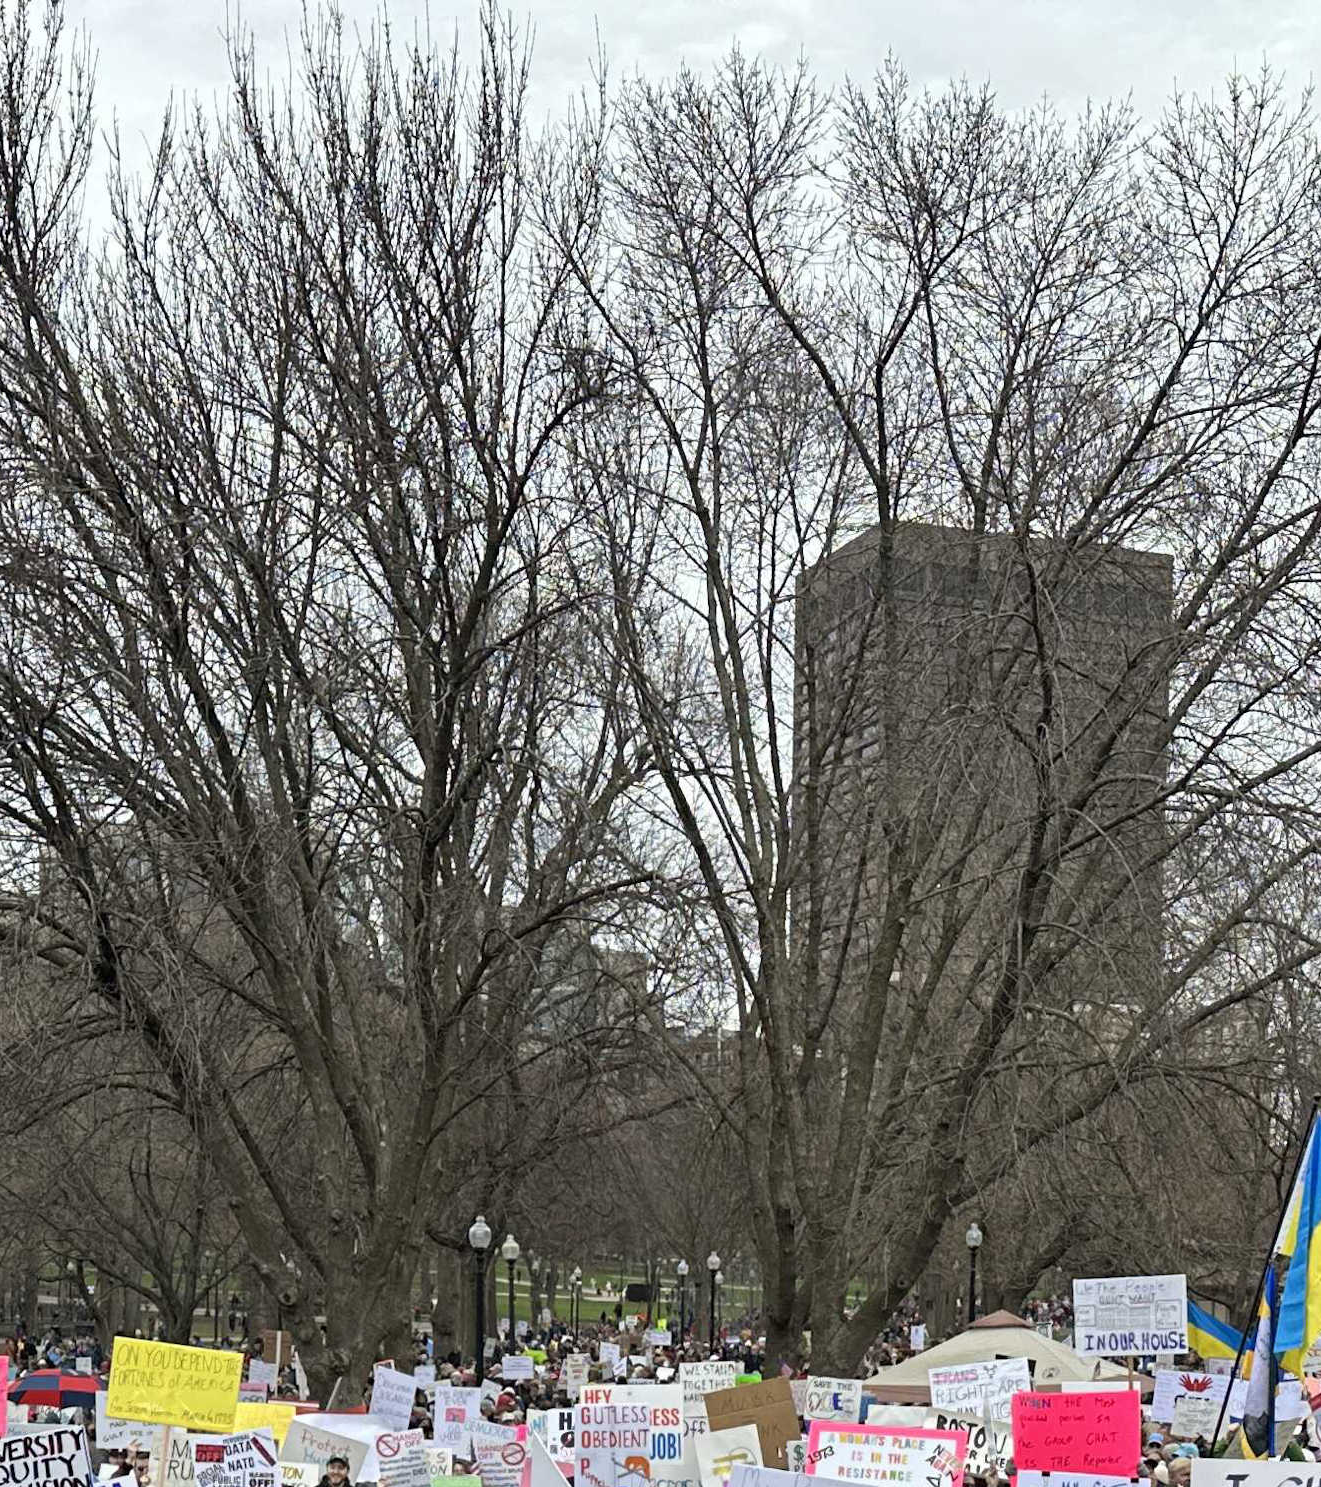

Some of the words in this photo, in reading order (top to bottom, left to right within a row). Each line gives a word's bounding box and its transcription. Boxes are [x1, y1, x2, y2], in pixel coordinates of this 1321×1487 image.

[1085, 1334, 1106, 1351] IN
[1108, 1333, 1138, 1351] OUR
[1141, 1331, 1186, 1350] HOUSE
[144, 1347, 172, 1369] YOU
[174, 1349, 223, 1373] DEPEND
[581, 1404, 647, 1426] GUTLESS
[581, 1429, 650, 1450] OBEDIENT
